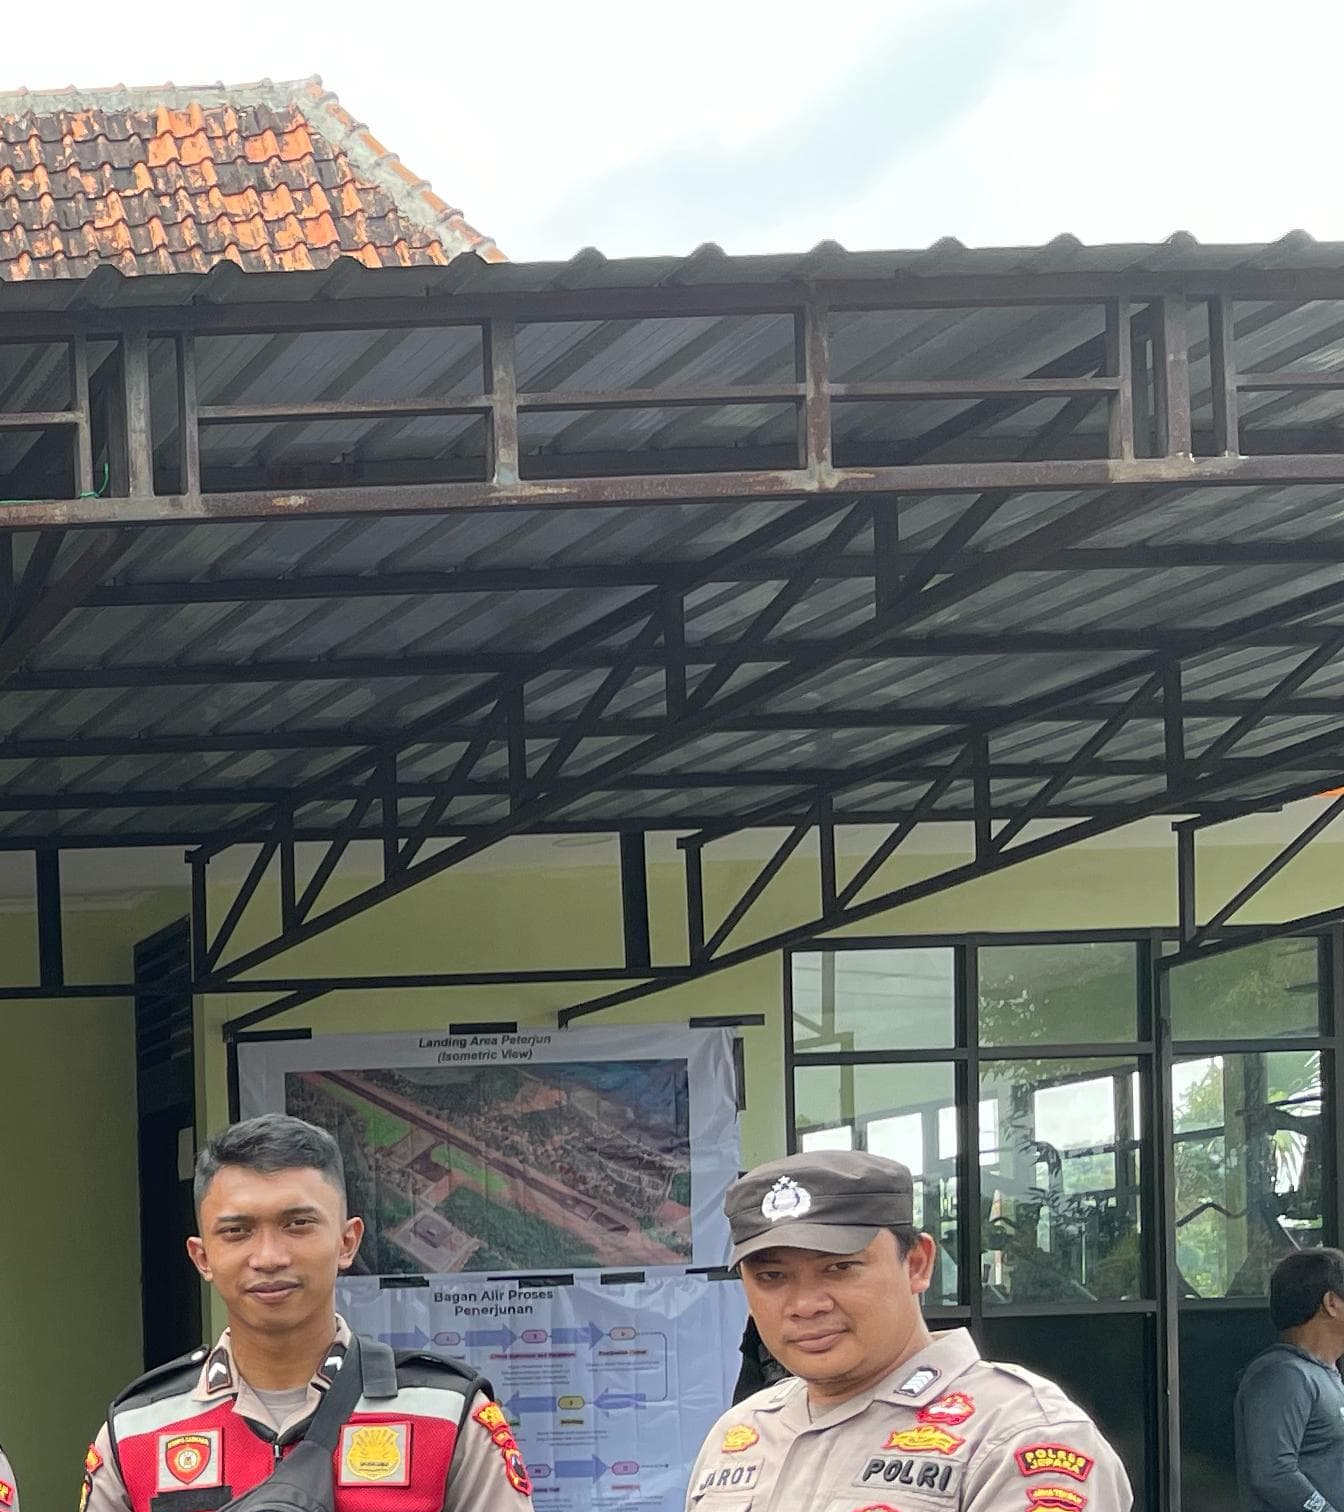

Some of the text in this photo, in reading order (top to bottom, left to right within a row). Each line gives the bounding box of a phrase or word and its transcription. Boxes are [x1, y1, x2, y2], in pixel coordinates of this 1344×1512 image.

[418, 1037, 468, 1049] Landing
[470, 1035, 499, 1046] Area
[437, 1049, 534, 1064] (Isometric View)
[433, 1288, 554, 1305] Bagan Alir Proses
[454, 1304, 534, 1317] Penerjunan
[1025, 1448, 1086, 1468] POLRES
[1030, 1457, 1081, 1474] JEPARA
[699, 1463, 758, 1491] JAROT
[862, 1458, 953, 1492] POLRI
